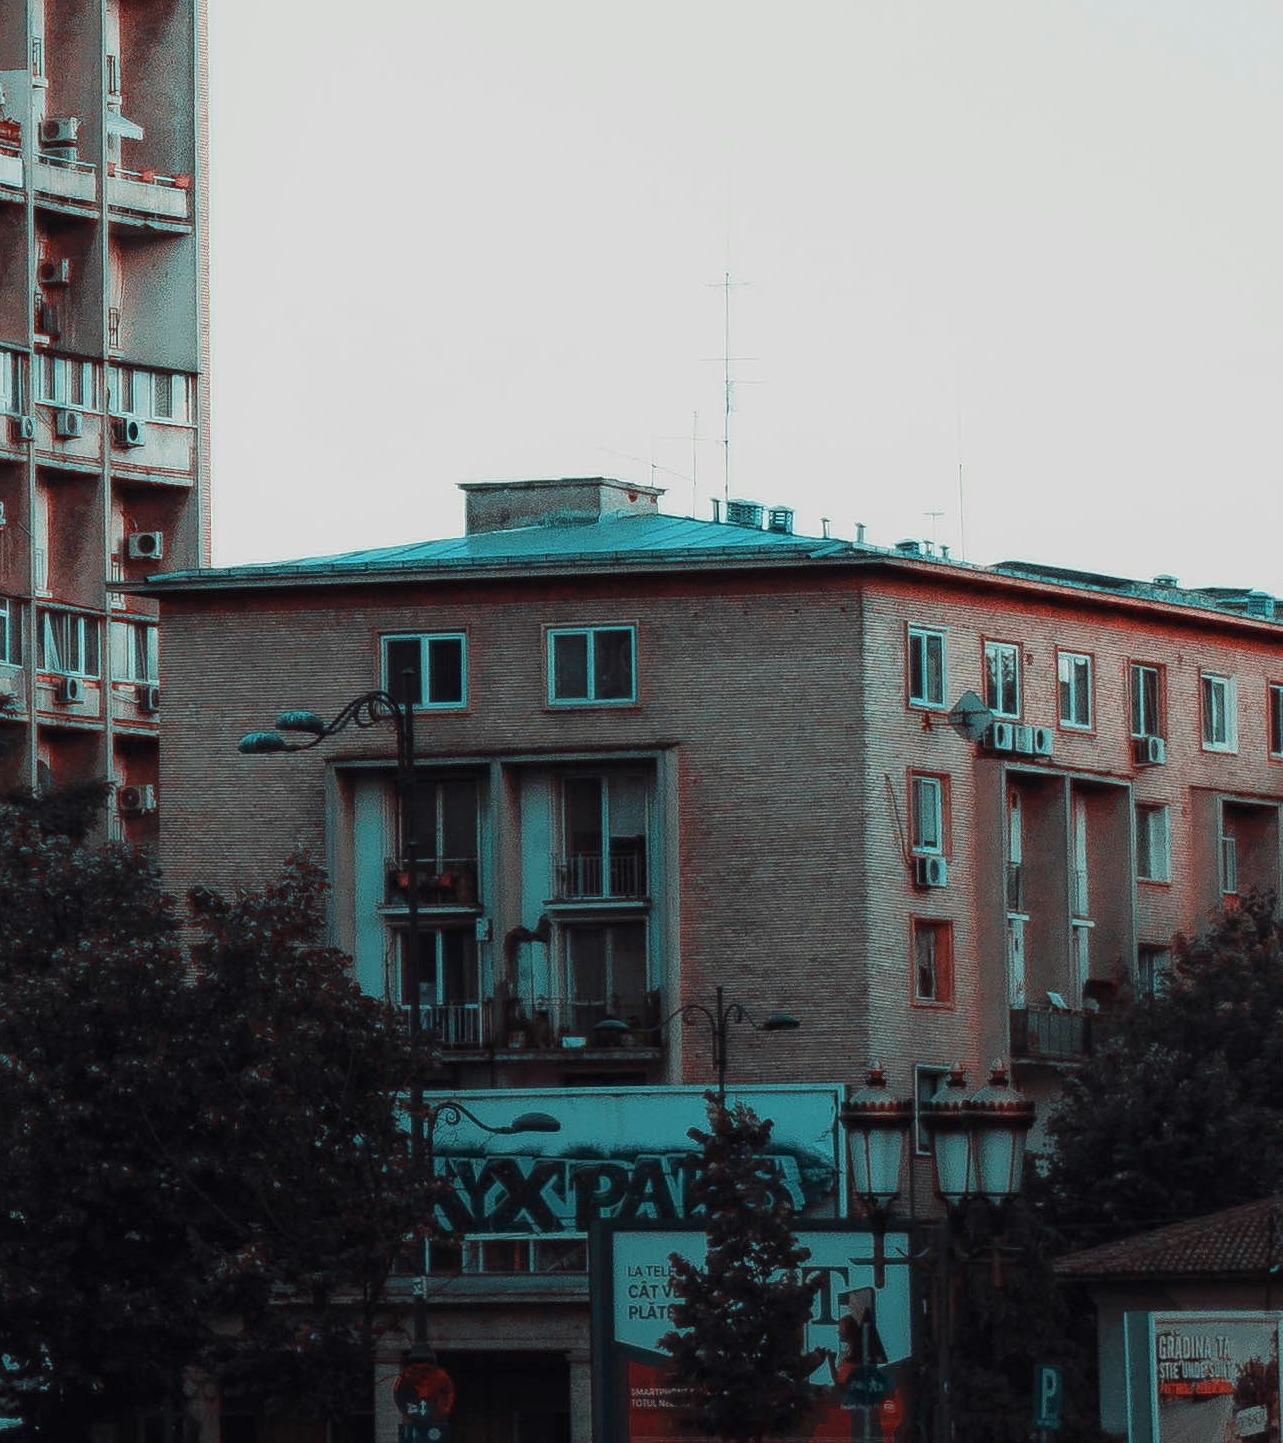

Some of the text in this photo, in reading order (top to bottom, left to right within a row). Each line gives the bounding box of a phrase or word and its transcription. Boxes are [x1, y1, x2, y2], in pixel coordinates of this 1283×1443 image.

[627, 1265, 642, 1276] LA
[628, 1281, 659, 1299] CÂT
[1041, 1368, 1057, 1418] P
